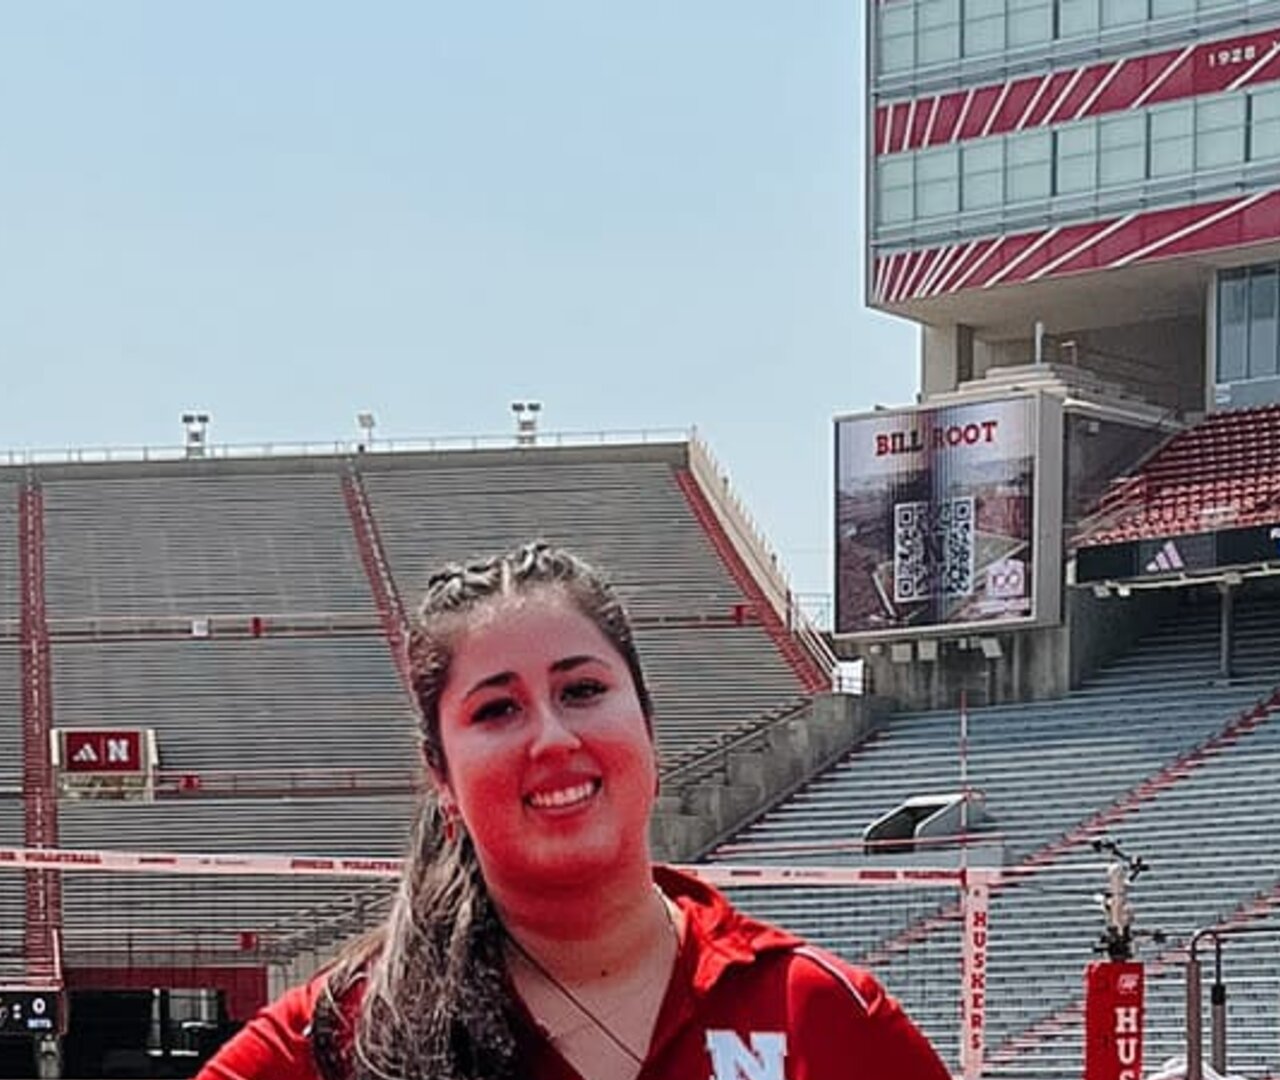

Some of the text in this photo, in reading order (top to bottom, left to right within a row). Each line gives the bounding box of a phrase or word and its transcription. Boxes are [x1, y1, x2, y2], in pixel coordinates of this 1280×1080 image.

[1208, 46, 1256, 67] 1928
[876, 421, 998, 457] BILL ROOT
[107, 738, 130, 763] N
[970, 911, 987, 1050] HUSKERS
[32, 998, 46, 1014] 0
